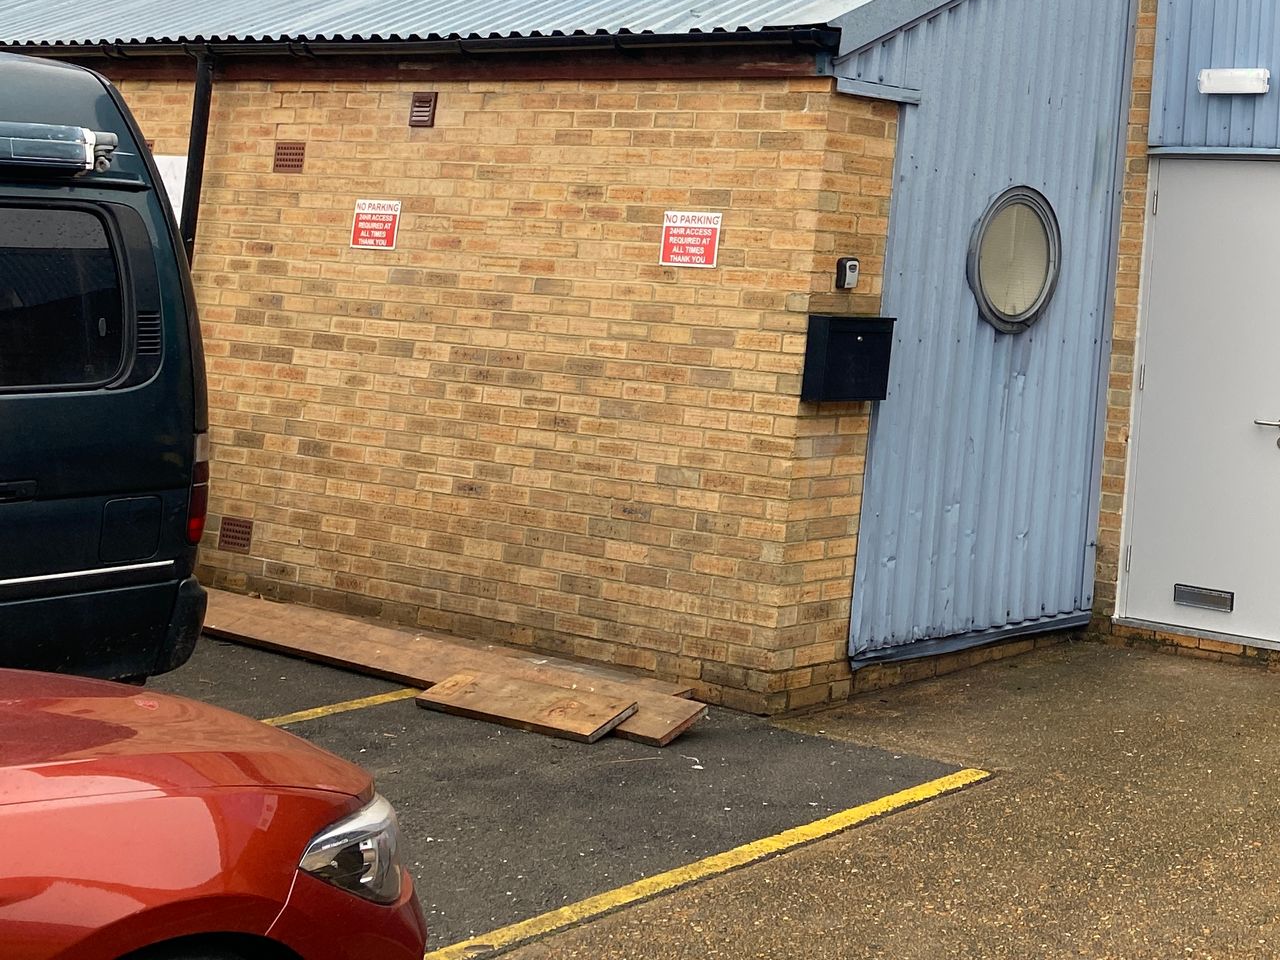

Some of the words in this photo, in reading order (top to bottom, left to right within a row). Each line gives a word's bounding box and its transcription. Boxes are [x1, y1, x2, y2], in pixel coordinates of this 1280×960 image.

[357, 202, 367, 211] NO
[368, 202, 400, 212] PARKING
[371, 214, 393, 222] ACCESS
[665, 214, 678, 224] NO
[680, 214, 720, 225] PARKING
[360, 230, 370, 238] ALL
[371, 230, 386, 238] TIMES
[669, 227, 685, 235] 24HR
[686, 228, 712, 236] ACCESS
[358, 238, 376, 246] THANK
[669, 236, 701, 245] REQUIRED
[672, 245, 684, 253] ALL
[685, 246, 705, 254] TIMES
[670, 254, 691, 263] THANK
[691, 255, 706, 263] YOU
